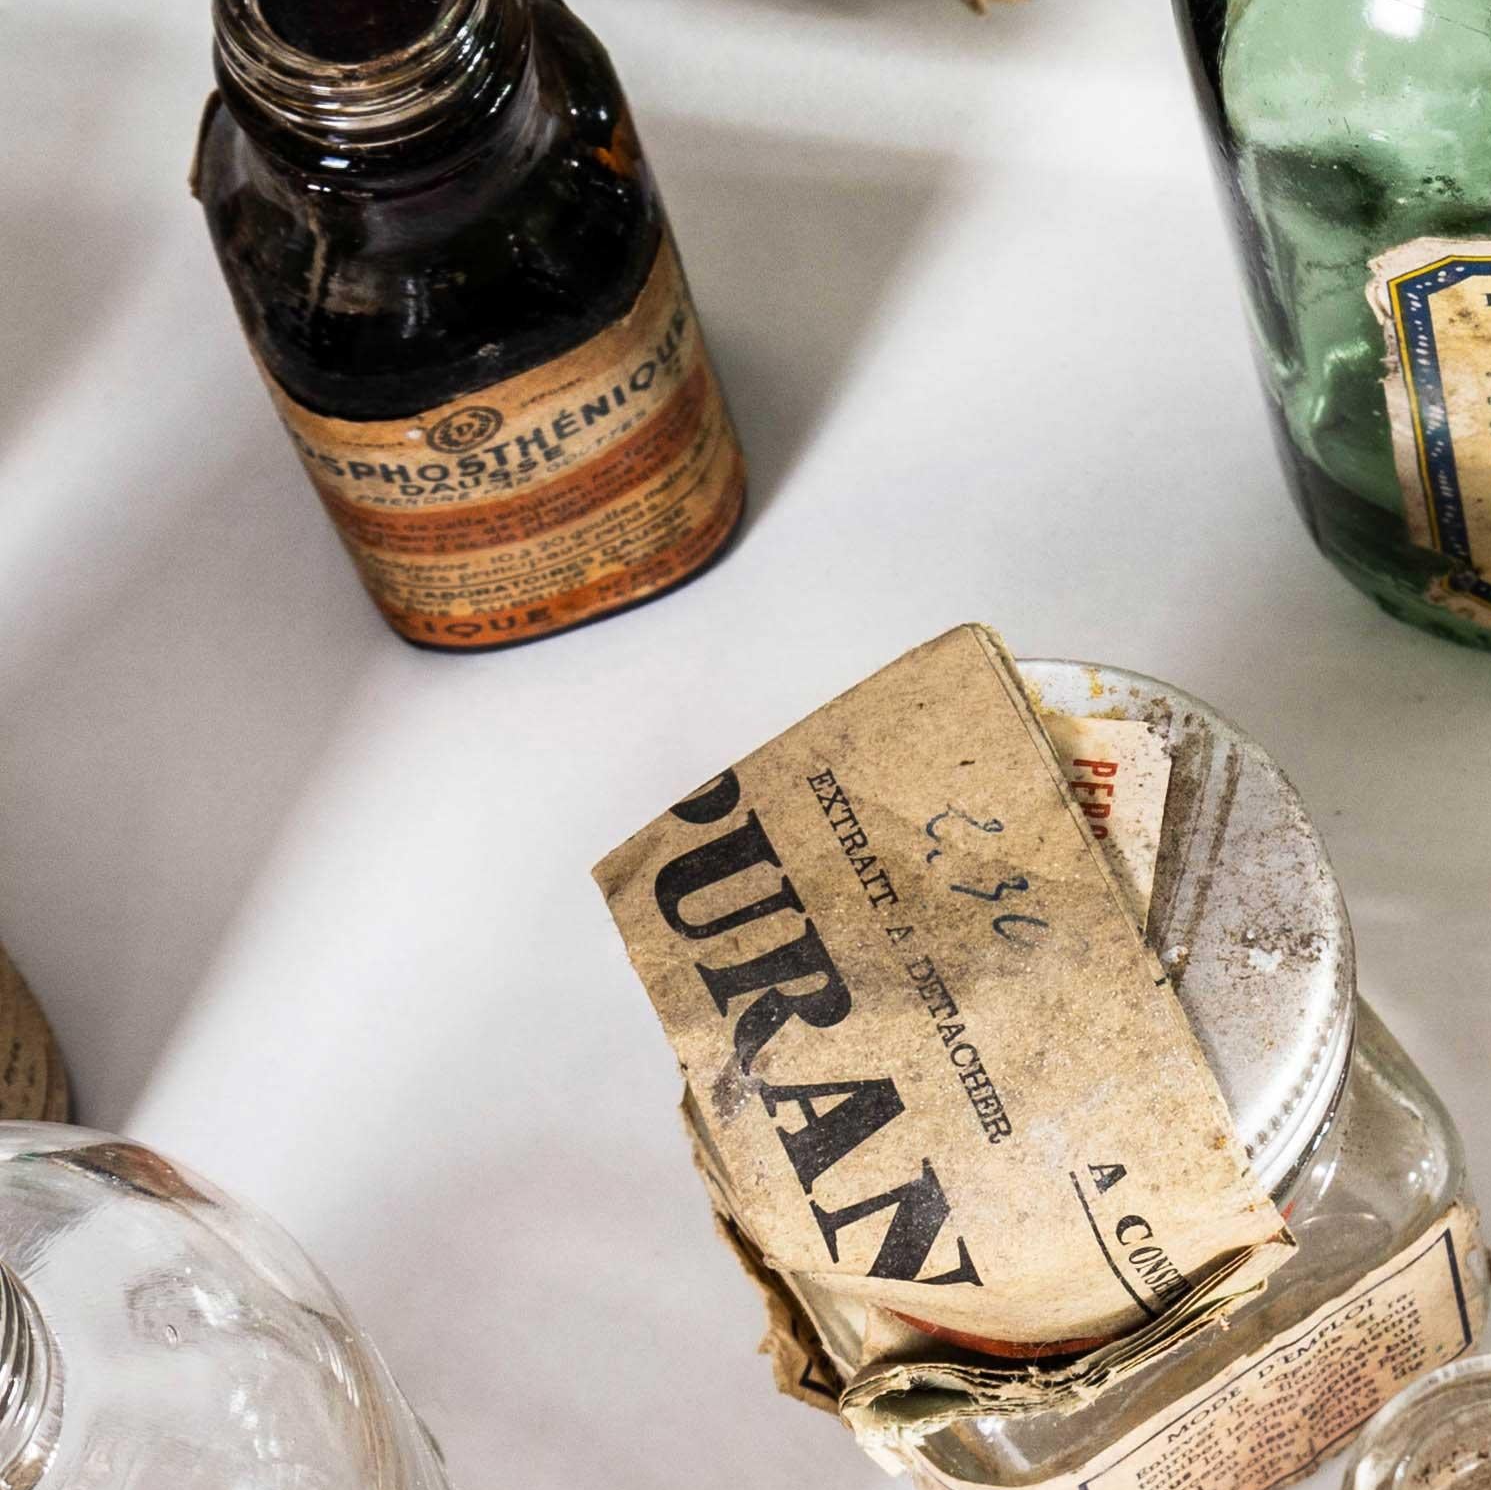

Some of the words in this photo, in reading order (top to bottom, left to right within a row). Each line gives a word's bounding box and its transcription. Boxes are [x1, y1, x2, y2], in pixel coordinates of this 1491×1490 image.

[399, 444, 563, 497] DAUSSE
[656, 768, 984, 1287] PURAN
[806, 768, 897, 911] EXTRAIT
[886, 925, 911, 946] A
[905, 956, 1016, 1145] DETACHER
[1086, 1162, 1130, 1194] A
[1166, 1386, 1240, 1443] MODE
[1258, 1297, 1372, 1379] D'EMPLOI
